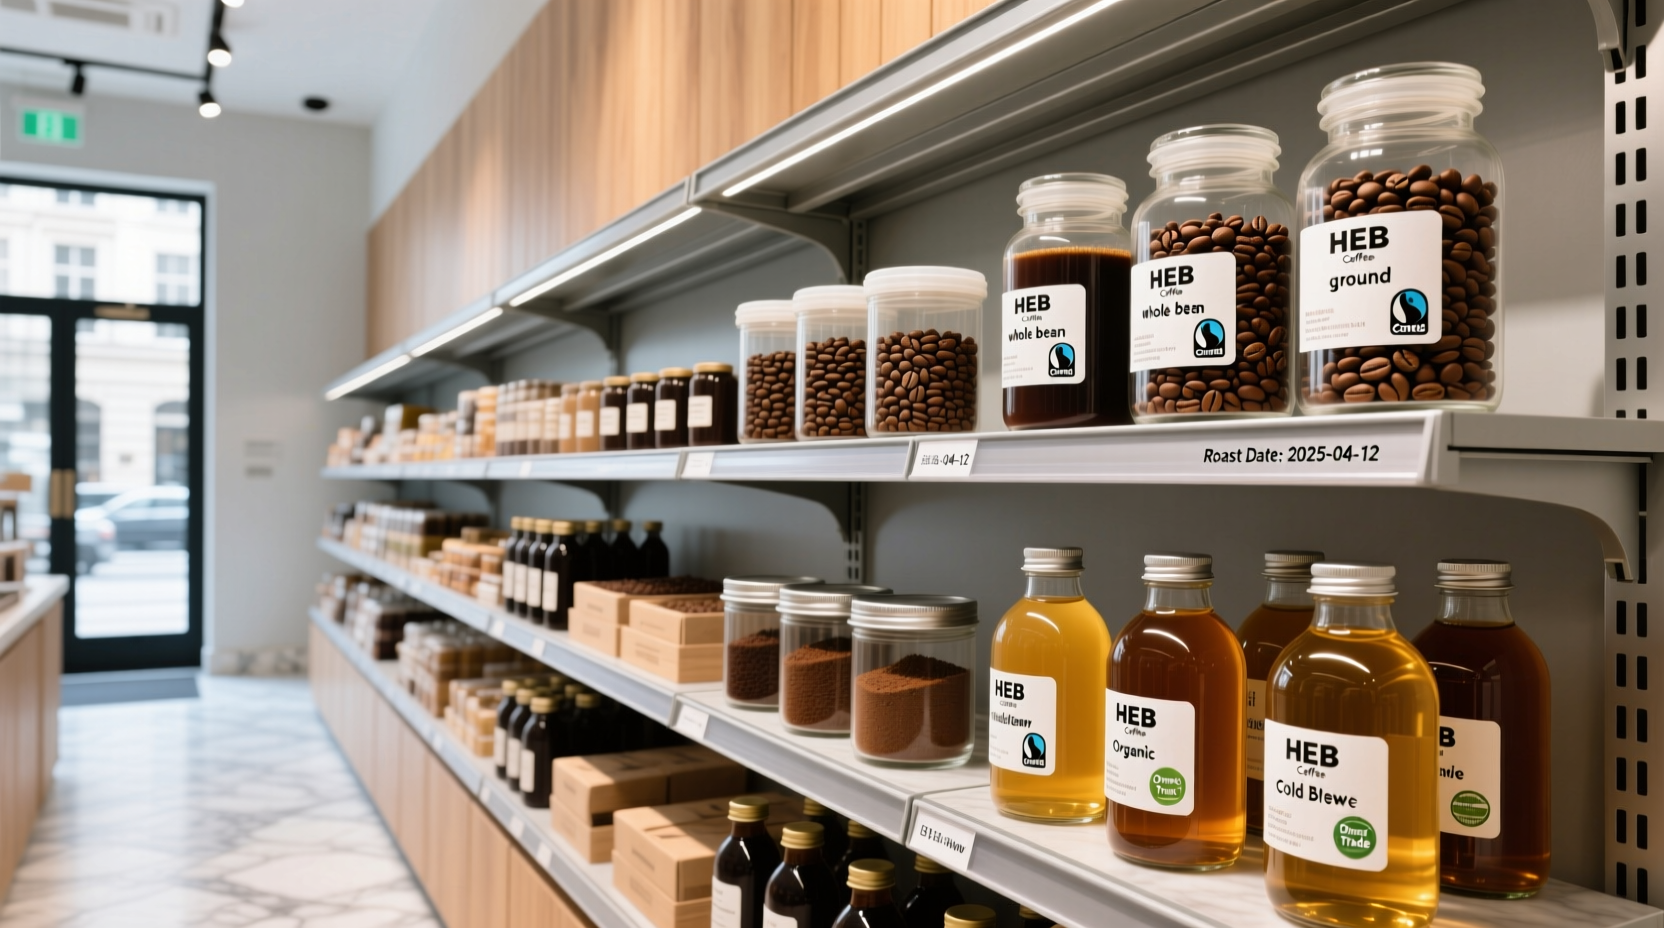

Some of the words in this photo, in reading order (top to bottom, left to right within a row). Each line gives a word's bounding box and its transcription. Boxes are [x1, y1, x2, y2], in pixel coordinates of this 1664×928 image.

[1329, 225, 1389, 254] HEB
[1150, 265, 1195, 290] HEB
[1329, 266, 1391, 293] ground
[1014, 294, 1051, 315] HEB
[1174, 301, 1205, 316] bean
[1008, 326, 1033, 343] whole
[1036, 325, 1066, 339] bean
[1203, 447, 1243, 464] Roast
[1245, 446, 1284, 463] Date:
[1287, 444, 1380, 463] 2025-04-12
[995, 678, 1025, 701] HEB
[1116, 702, 1157, 729] HEB
[1112, 739, 1156, 761] Organic
[1286, 737, 1339, 768] HEB
[1276, 779, 1304, 799] Cold
